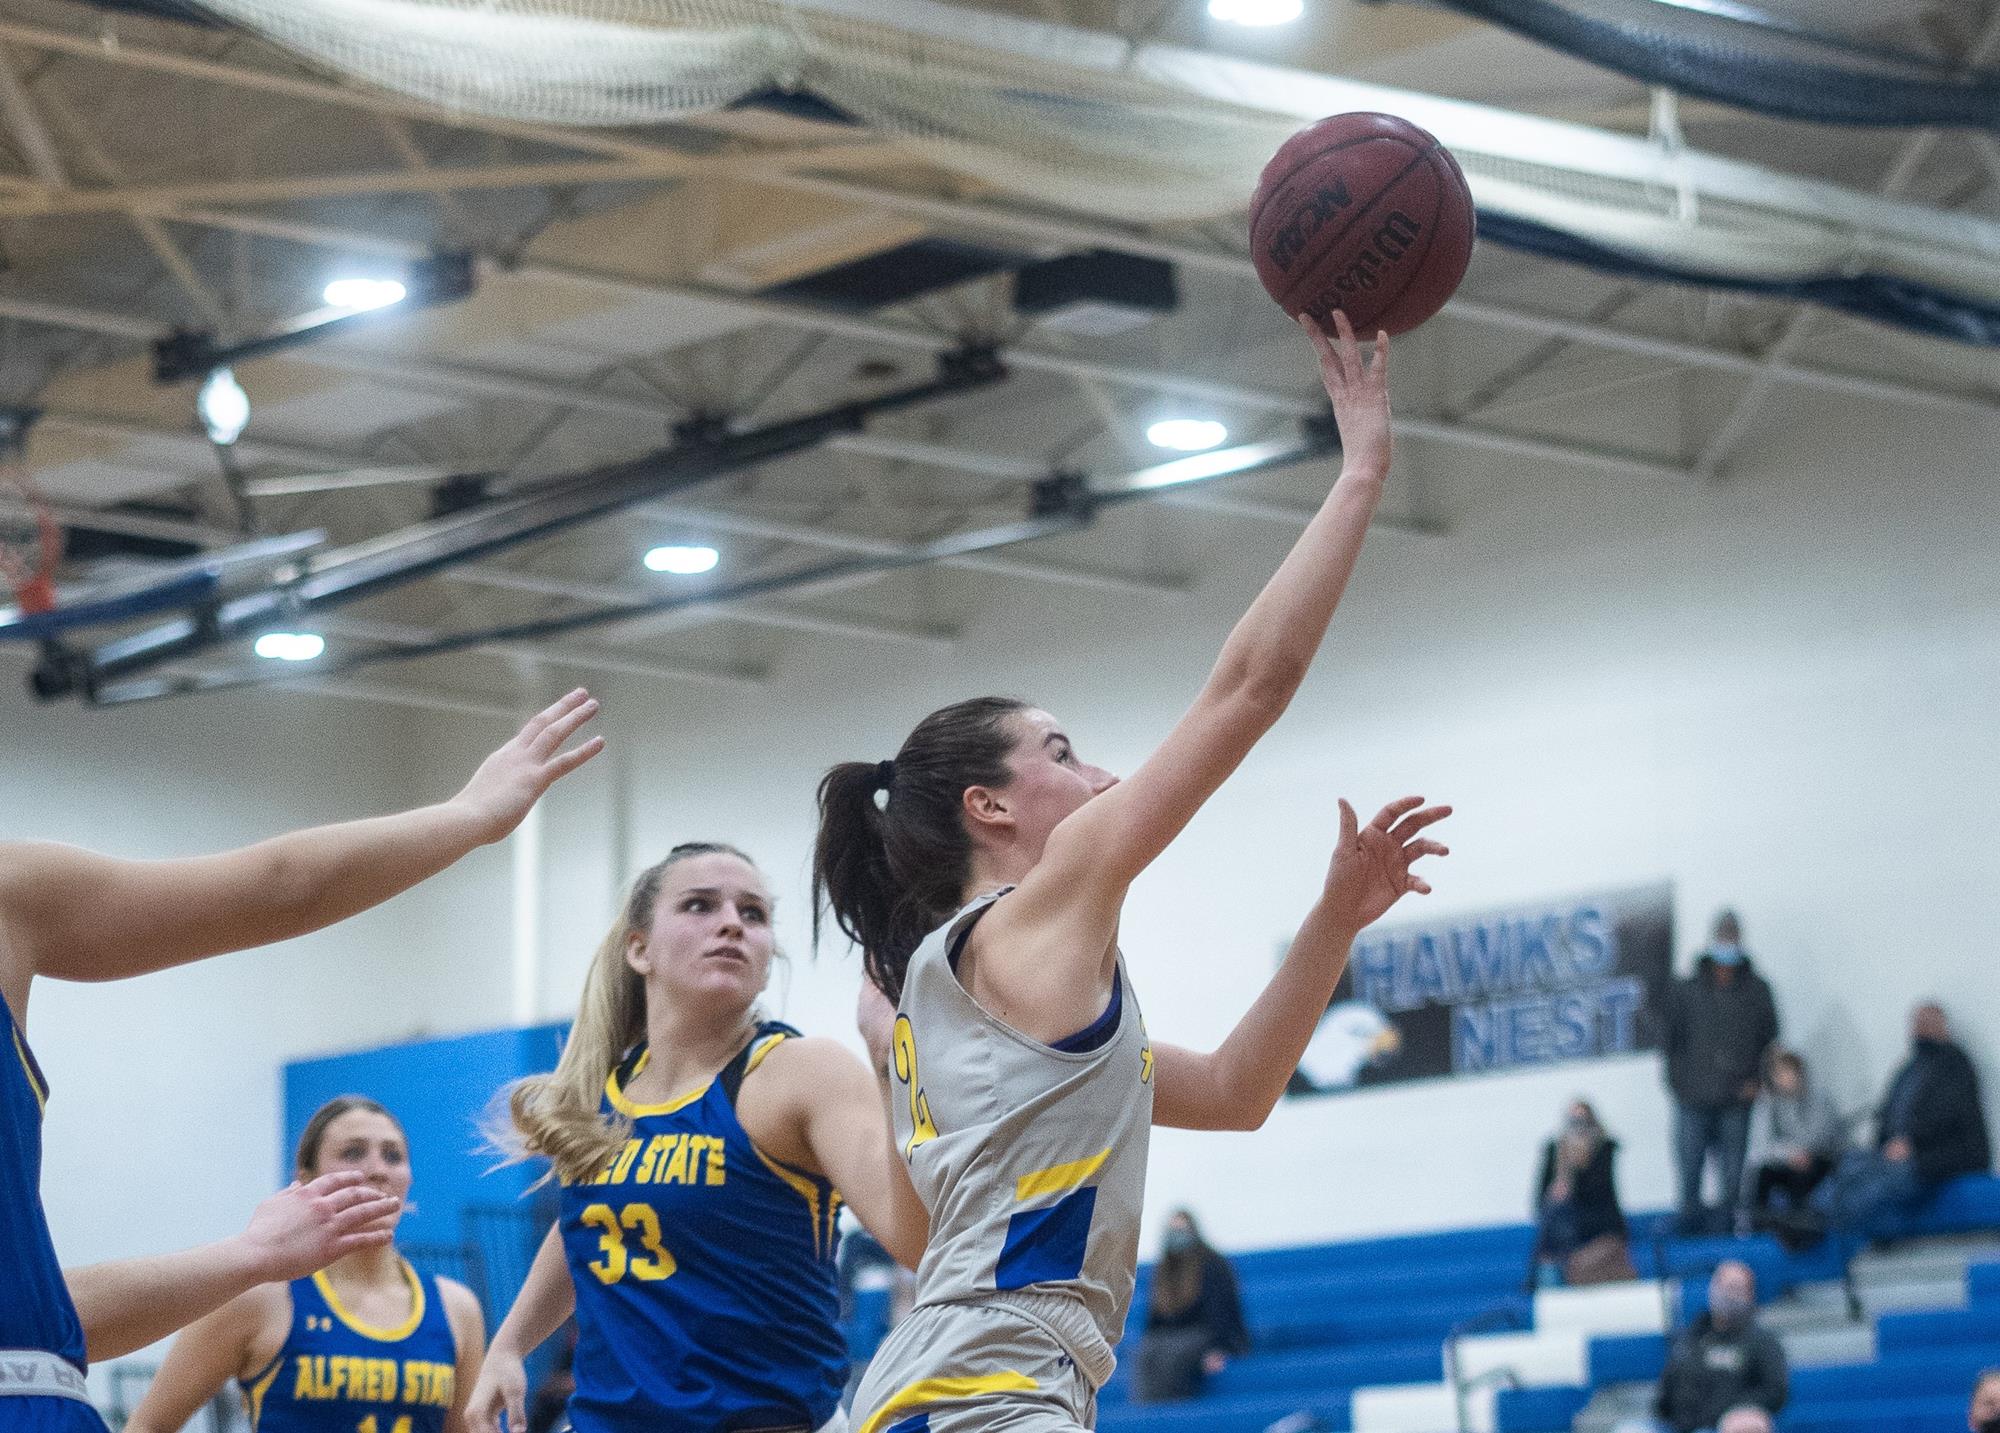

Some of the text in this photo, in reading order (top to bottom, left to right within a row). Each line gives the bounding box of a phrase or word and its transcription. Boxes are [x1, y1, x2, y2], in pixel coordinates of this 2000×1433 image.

[1268, 175, 1352, 272] NCAA
[1353, 907, 1613, 1003] HAWKS
[1455, 980, 1641, 1070] NEST
[636, 1133, 726, 1186] STATE
[580, 1203, 677, 1285] 33
[295, 1354, 398, 1401] ALFRED
